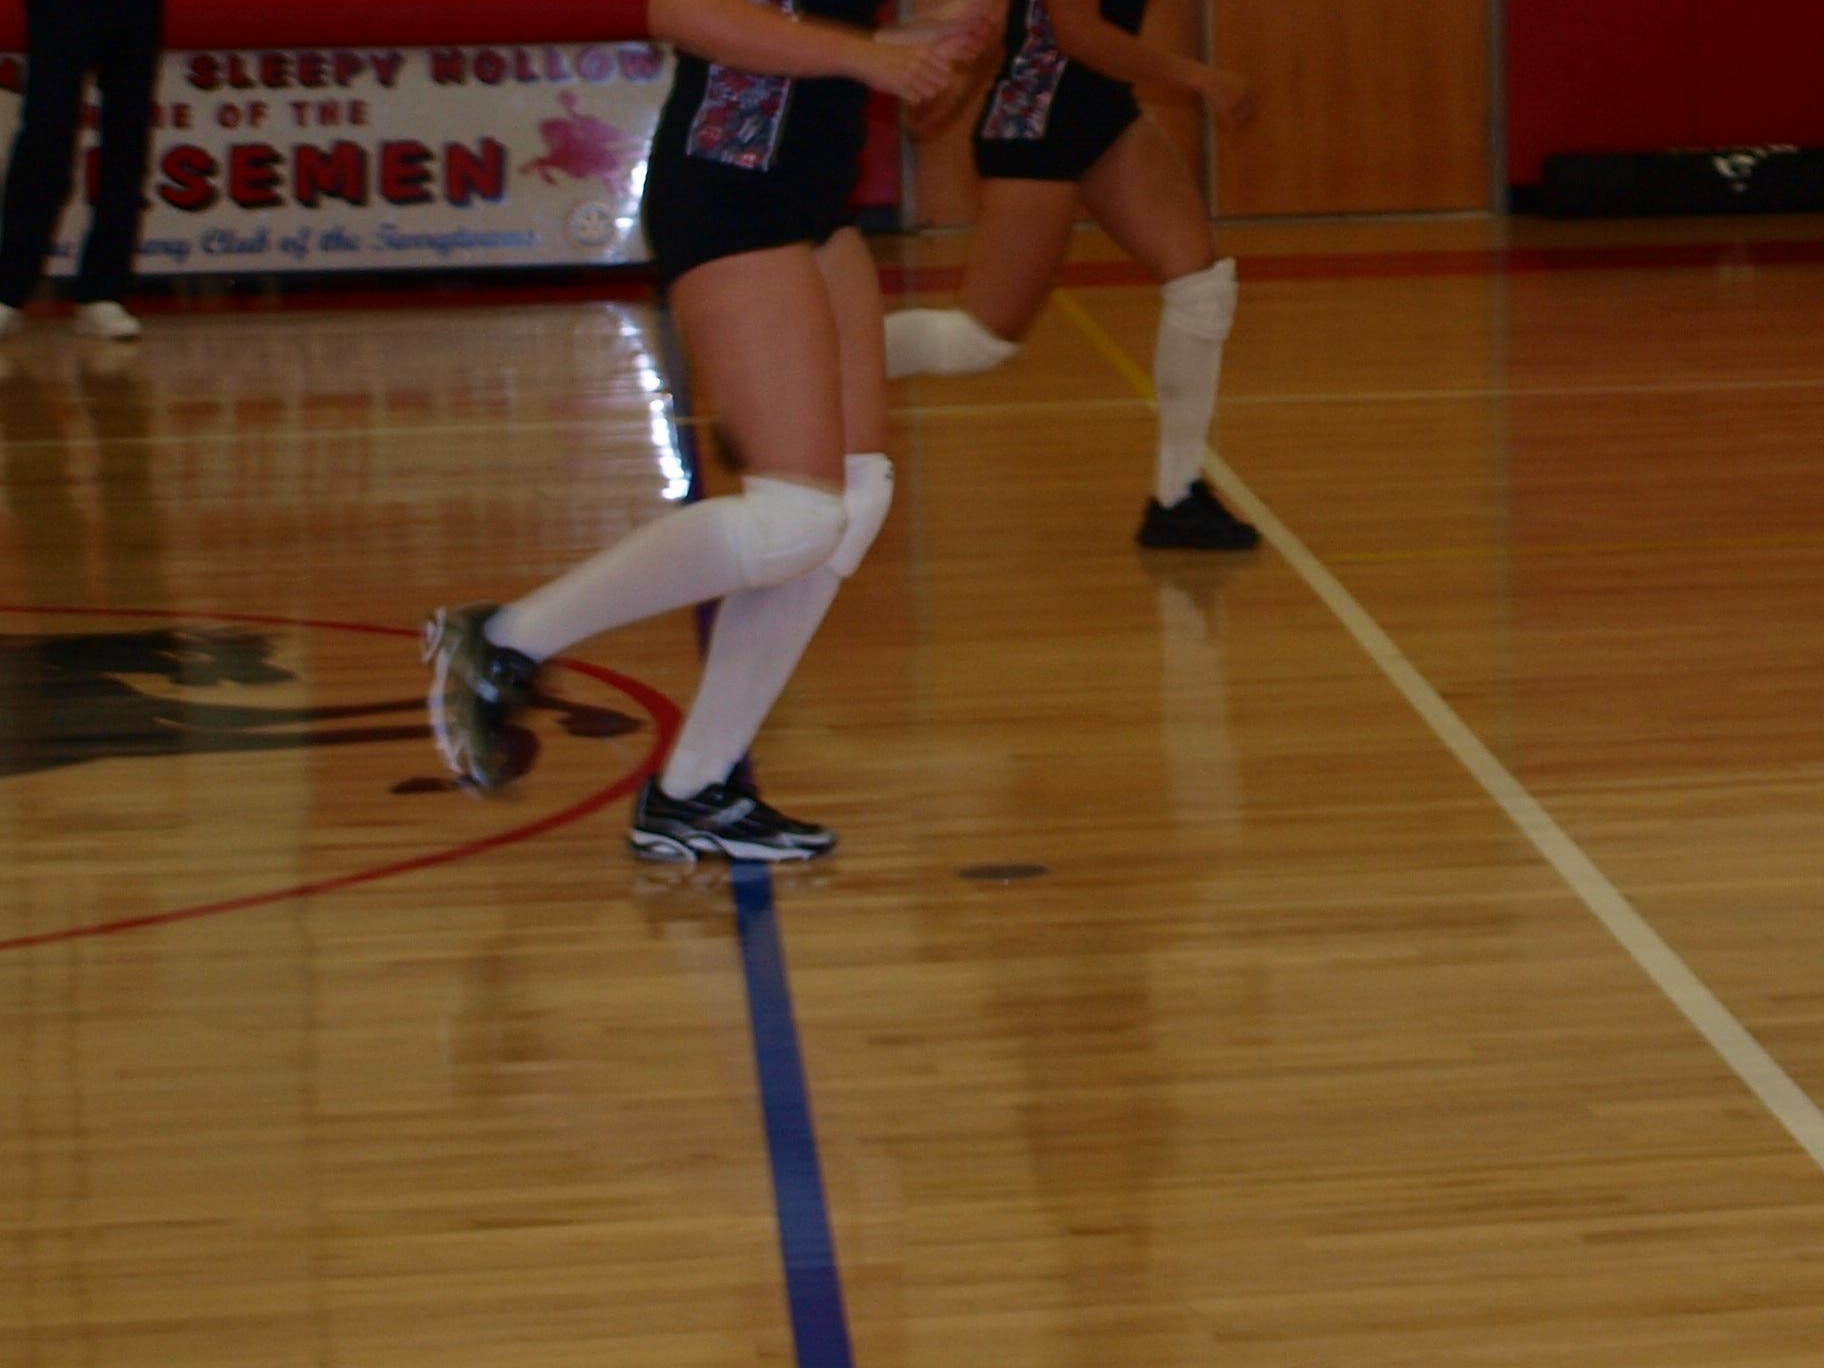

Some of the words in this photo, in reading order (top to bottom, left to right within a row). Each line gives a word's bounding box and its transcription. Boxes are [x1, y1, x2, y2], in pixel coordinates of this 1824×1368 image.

[189, 53, 403, 90] SLEEPY
[430, 44, 665, 85] HOLLOW
[217, 102, 267, 128] OF
[292, 100, 368, 126] THE
[88, 138, 508, 212] SEMEN
